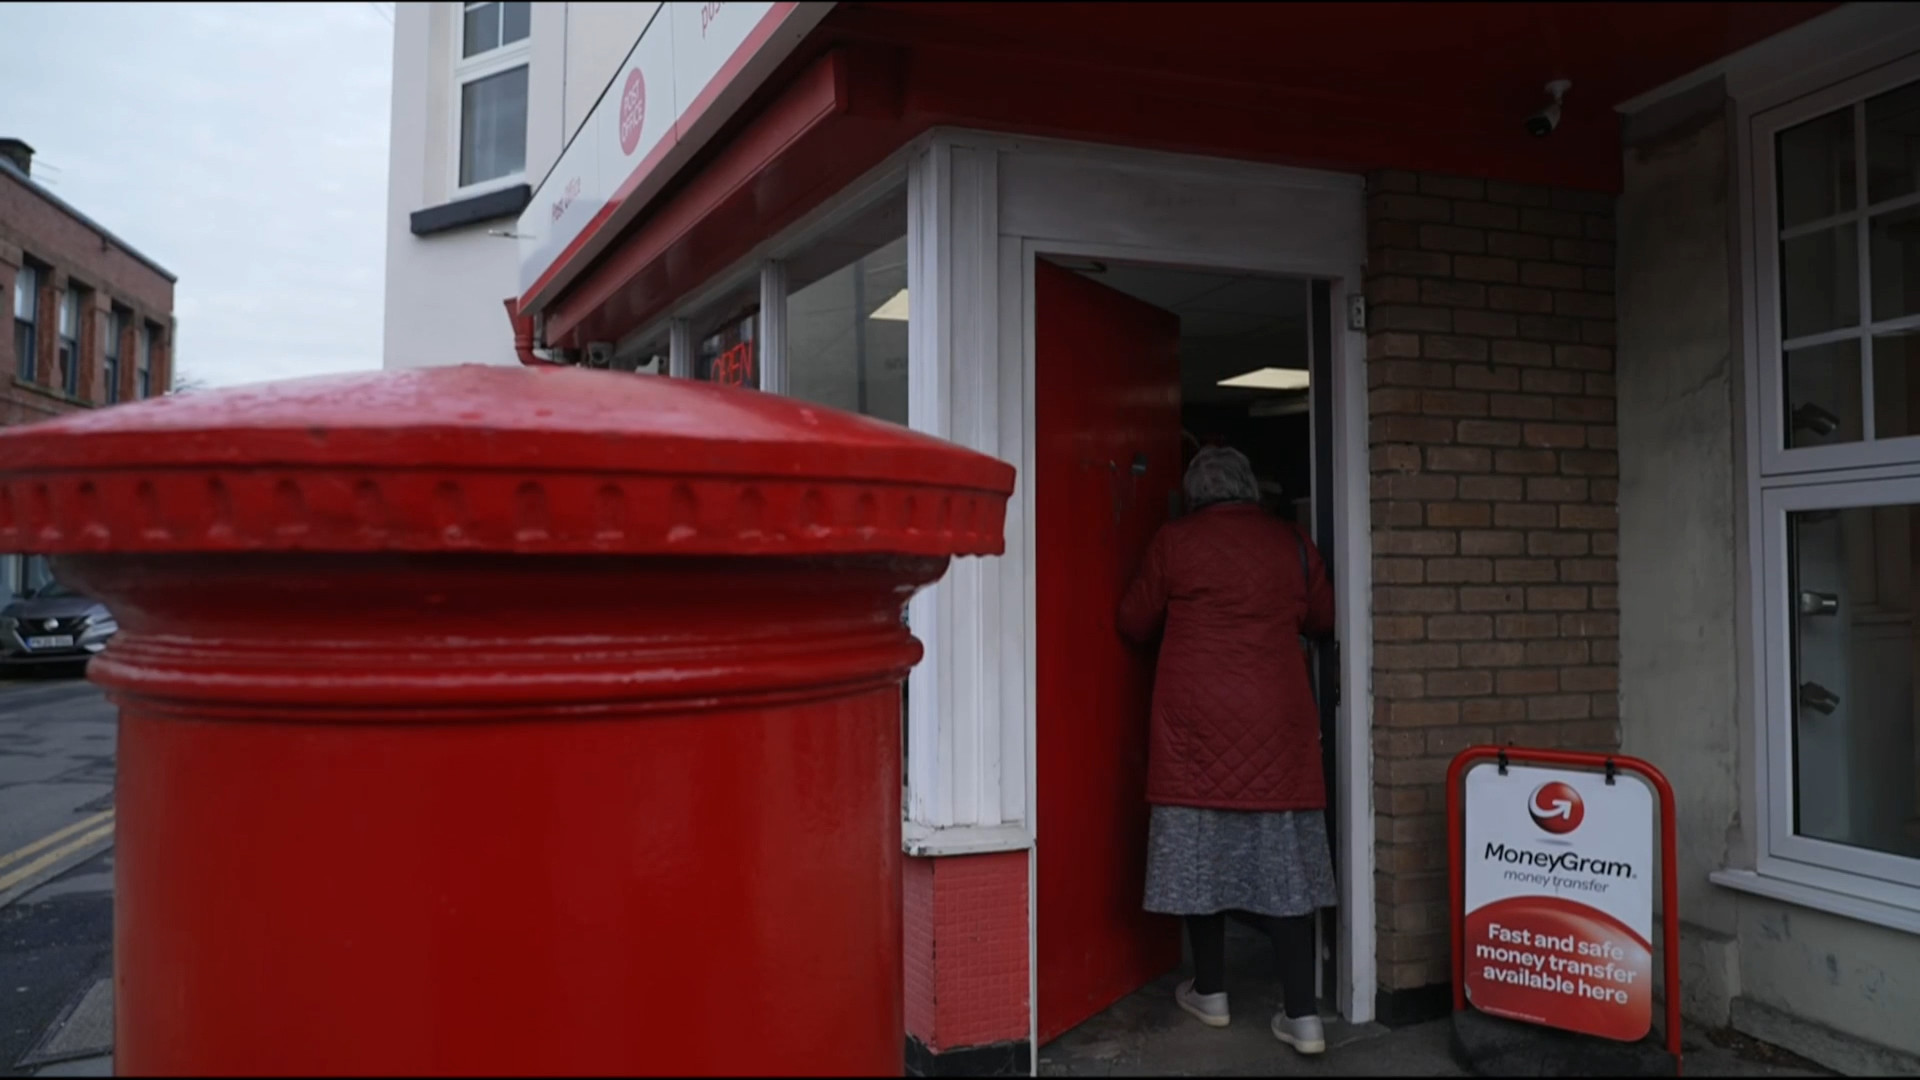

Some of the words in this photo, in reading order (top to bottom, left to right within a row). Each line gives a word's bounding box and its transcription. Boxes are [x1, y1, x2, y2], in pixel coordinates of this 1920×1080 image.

[624, 78, 641, 115] POST
[621, 98, 643, 143] OFFICE
[710, 336, 753, 386] OPEN
[1504, 870, 1550, 887] money
[1552, 876, 1609, 893] transfer
[1488, 923, 1531, 945] Fast
[1534, 935, 1574, 952] and
[1577, 940, 1624, 961] safe
[1476, 944, 1545, 972] money
[1548, 955, 1637, 984] transfer
[1483, 966, 1575, 994] available
[1578, 979, 1628, 1004] here
